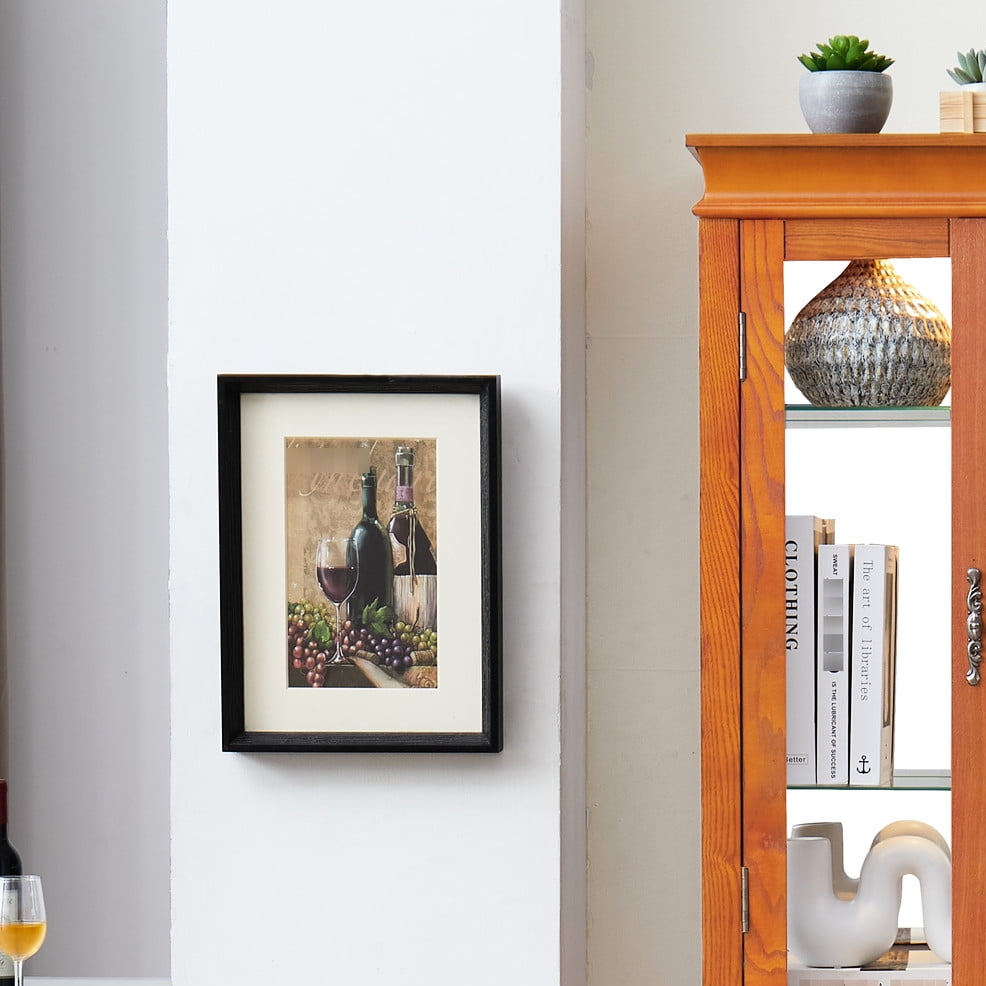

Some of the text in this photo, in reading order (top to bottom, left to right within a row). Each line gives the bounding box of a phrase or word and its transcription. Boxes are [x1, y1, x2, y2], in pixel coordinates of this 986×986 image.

[785, 540, 798, 651] CLOTHING
[860, 560, 874, 701] The art of libraries
[830, 739, 837, 748] OF
